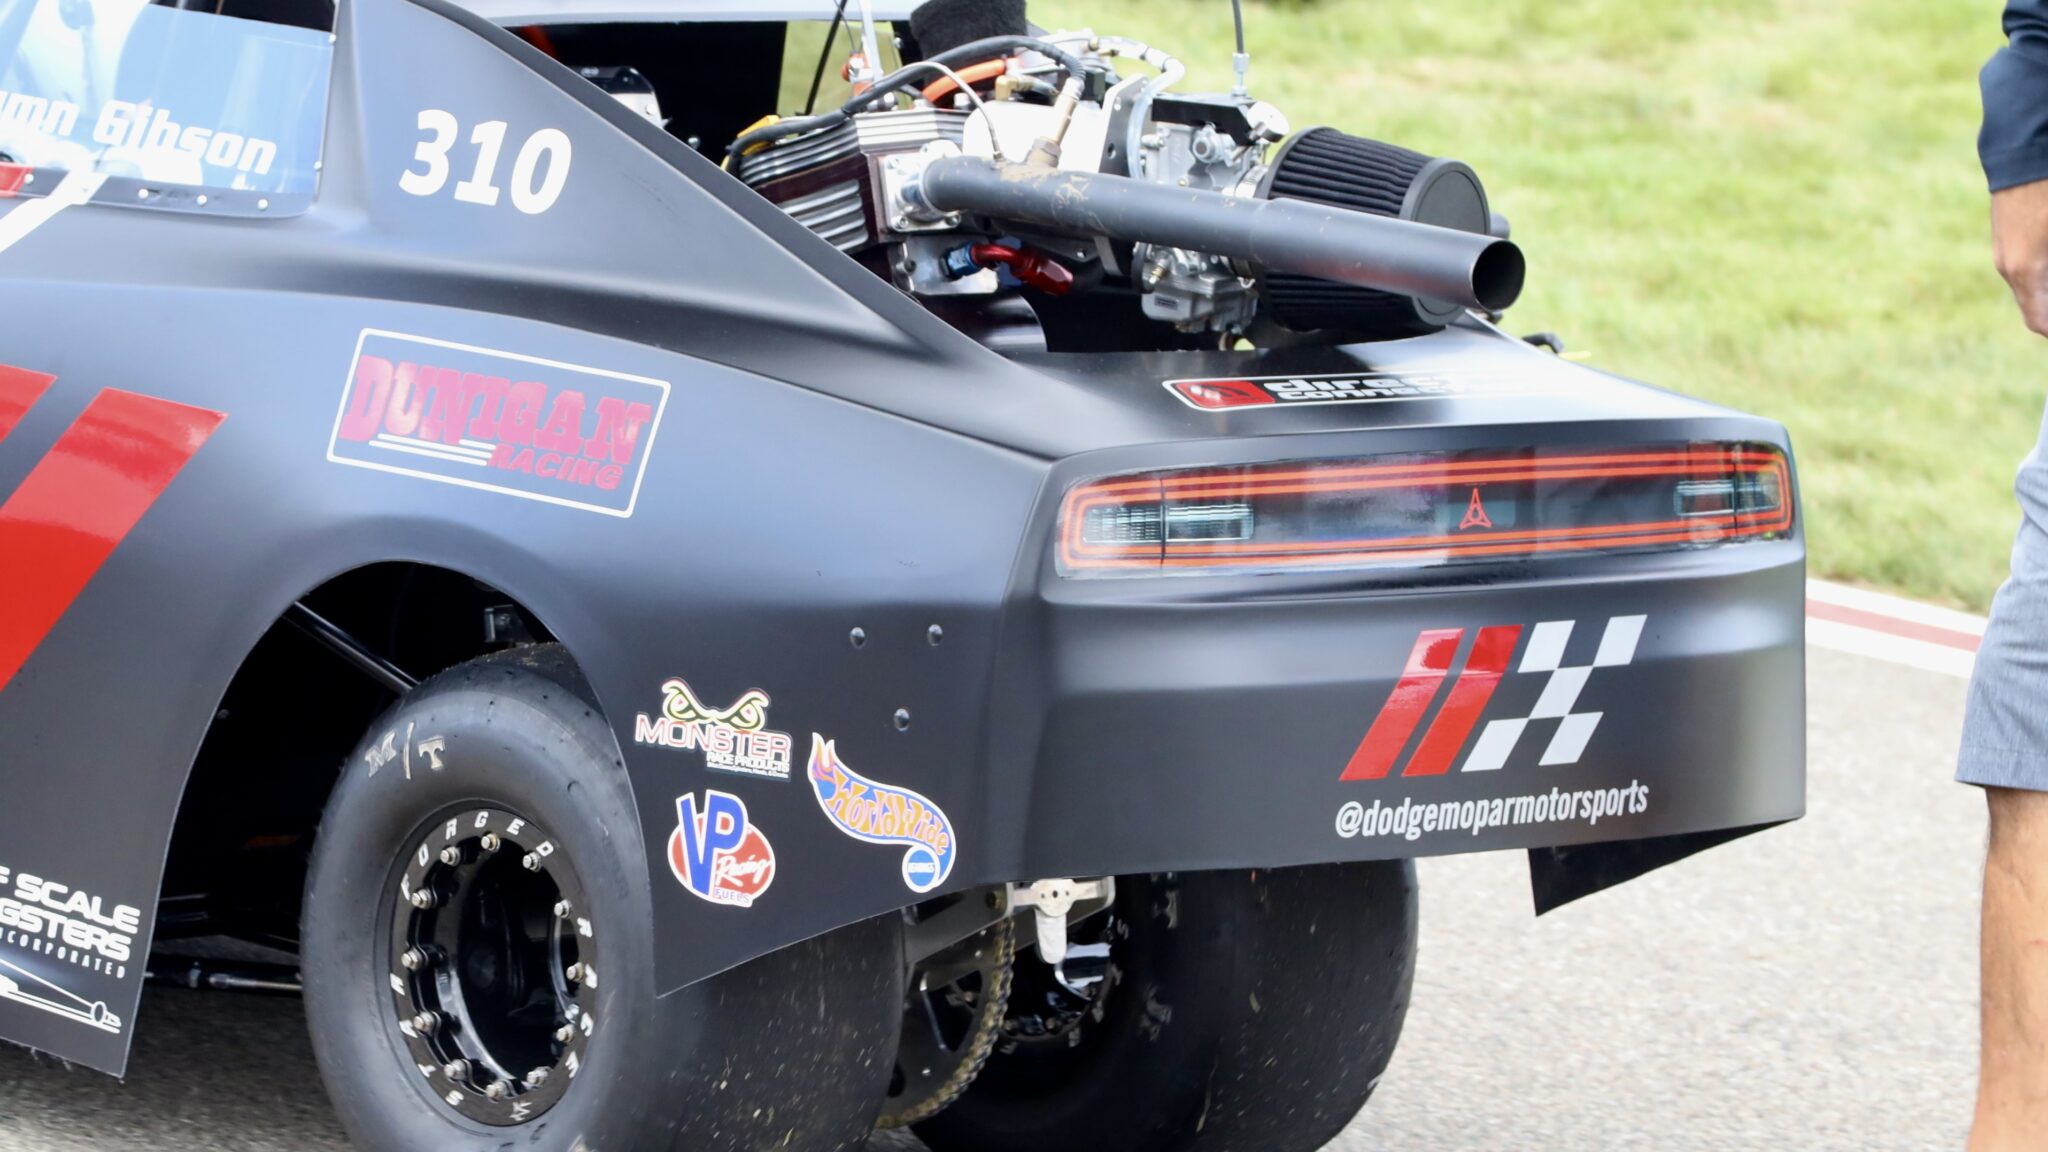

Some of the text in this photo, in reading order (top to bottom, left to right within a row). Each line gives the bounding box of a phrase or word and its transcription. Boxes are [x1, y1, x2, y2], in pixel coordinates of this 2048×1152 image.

[0, 90, 277, 175] mn Gibson
[398, 109, 572, 214] 310
[338, 354, 653, 466] DUNIGAN
[1264, 374, 1456, 392] direc
[487, 444, 624, 491] RACING
[635, 713, 791, 761] MONSTER
[1335, 779, 1649, 840] @dodgemoparmotorsports
[677, 790, 747, 898] VP
[716, 855, 771, 887] Racing
[14, 872, 141, 934] SCALE
[714, 886, 750, 904] FUELS
